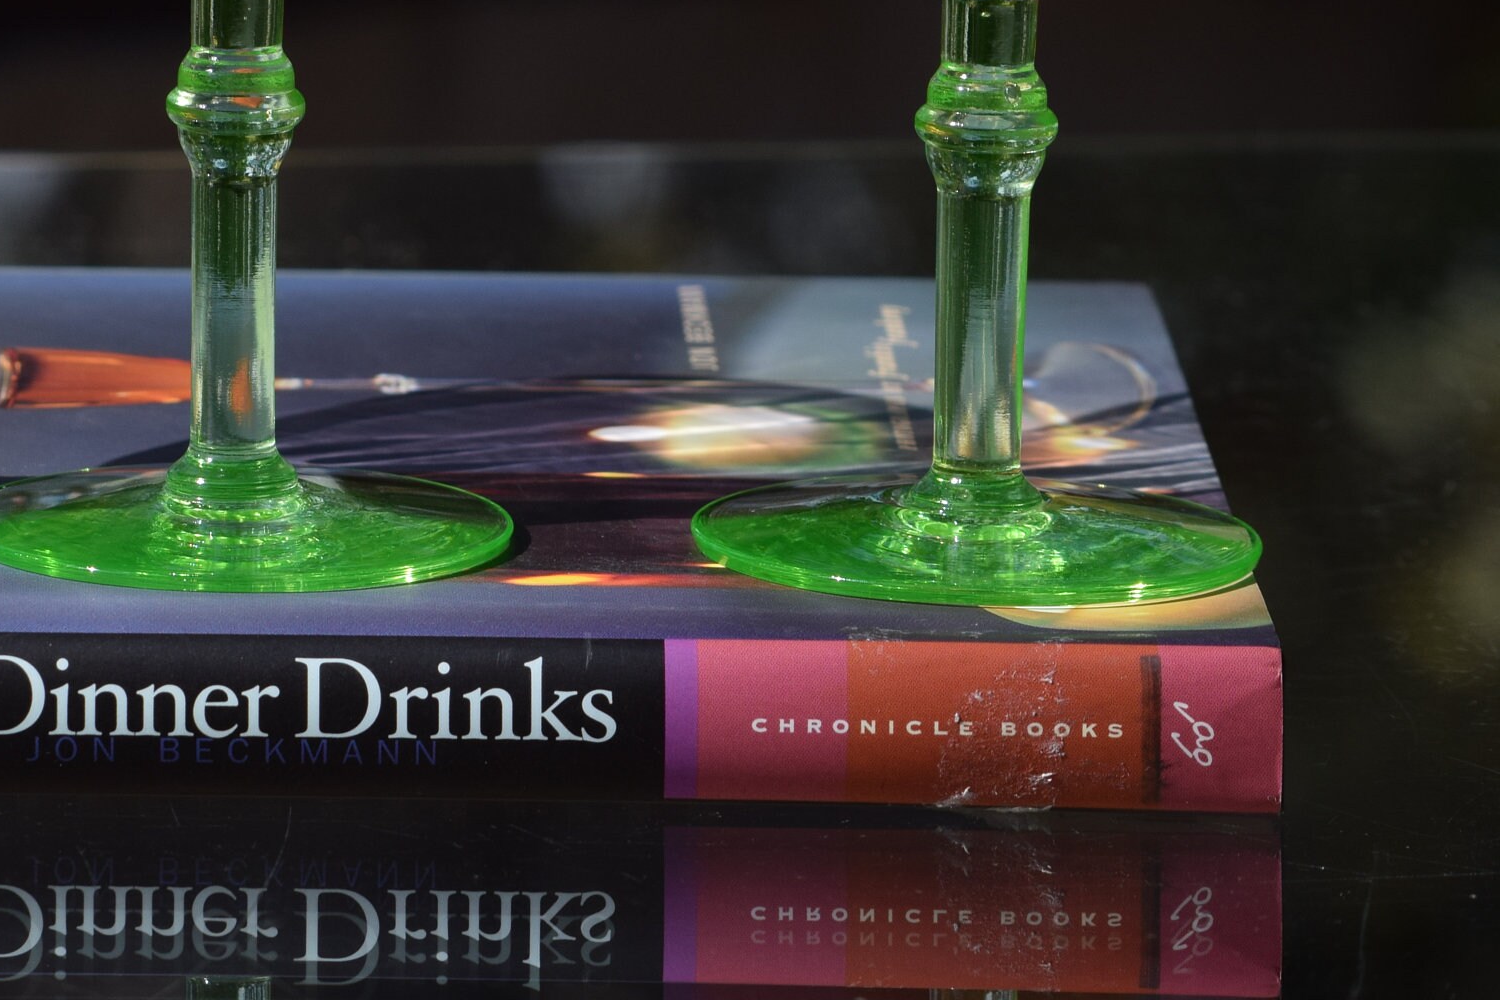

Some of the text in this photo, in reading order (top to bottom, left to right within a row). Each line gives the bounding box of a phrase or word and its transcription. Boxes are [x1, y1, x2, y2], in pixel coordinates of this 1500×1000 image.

[294, 656, 618, 744] Drinks
[751, 717, 1125, 740] CHRONICLE BOOKS
[26, 737, 438, 765] JON BECKMANN
